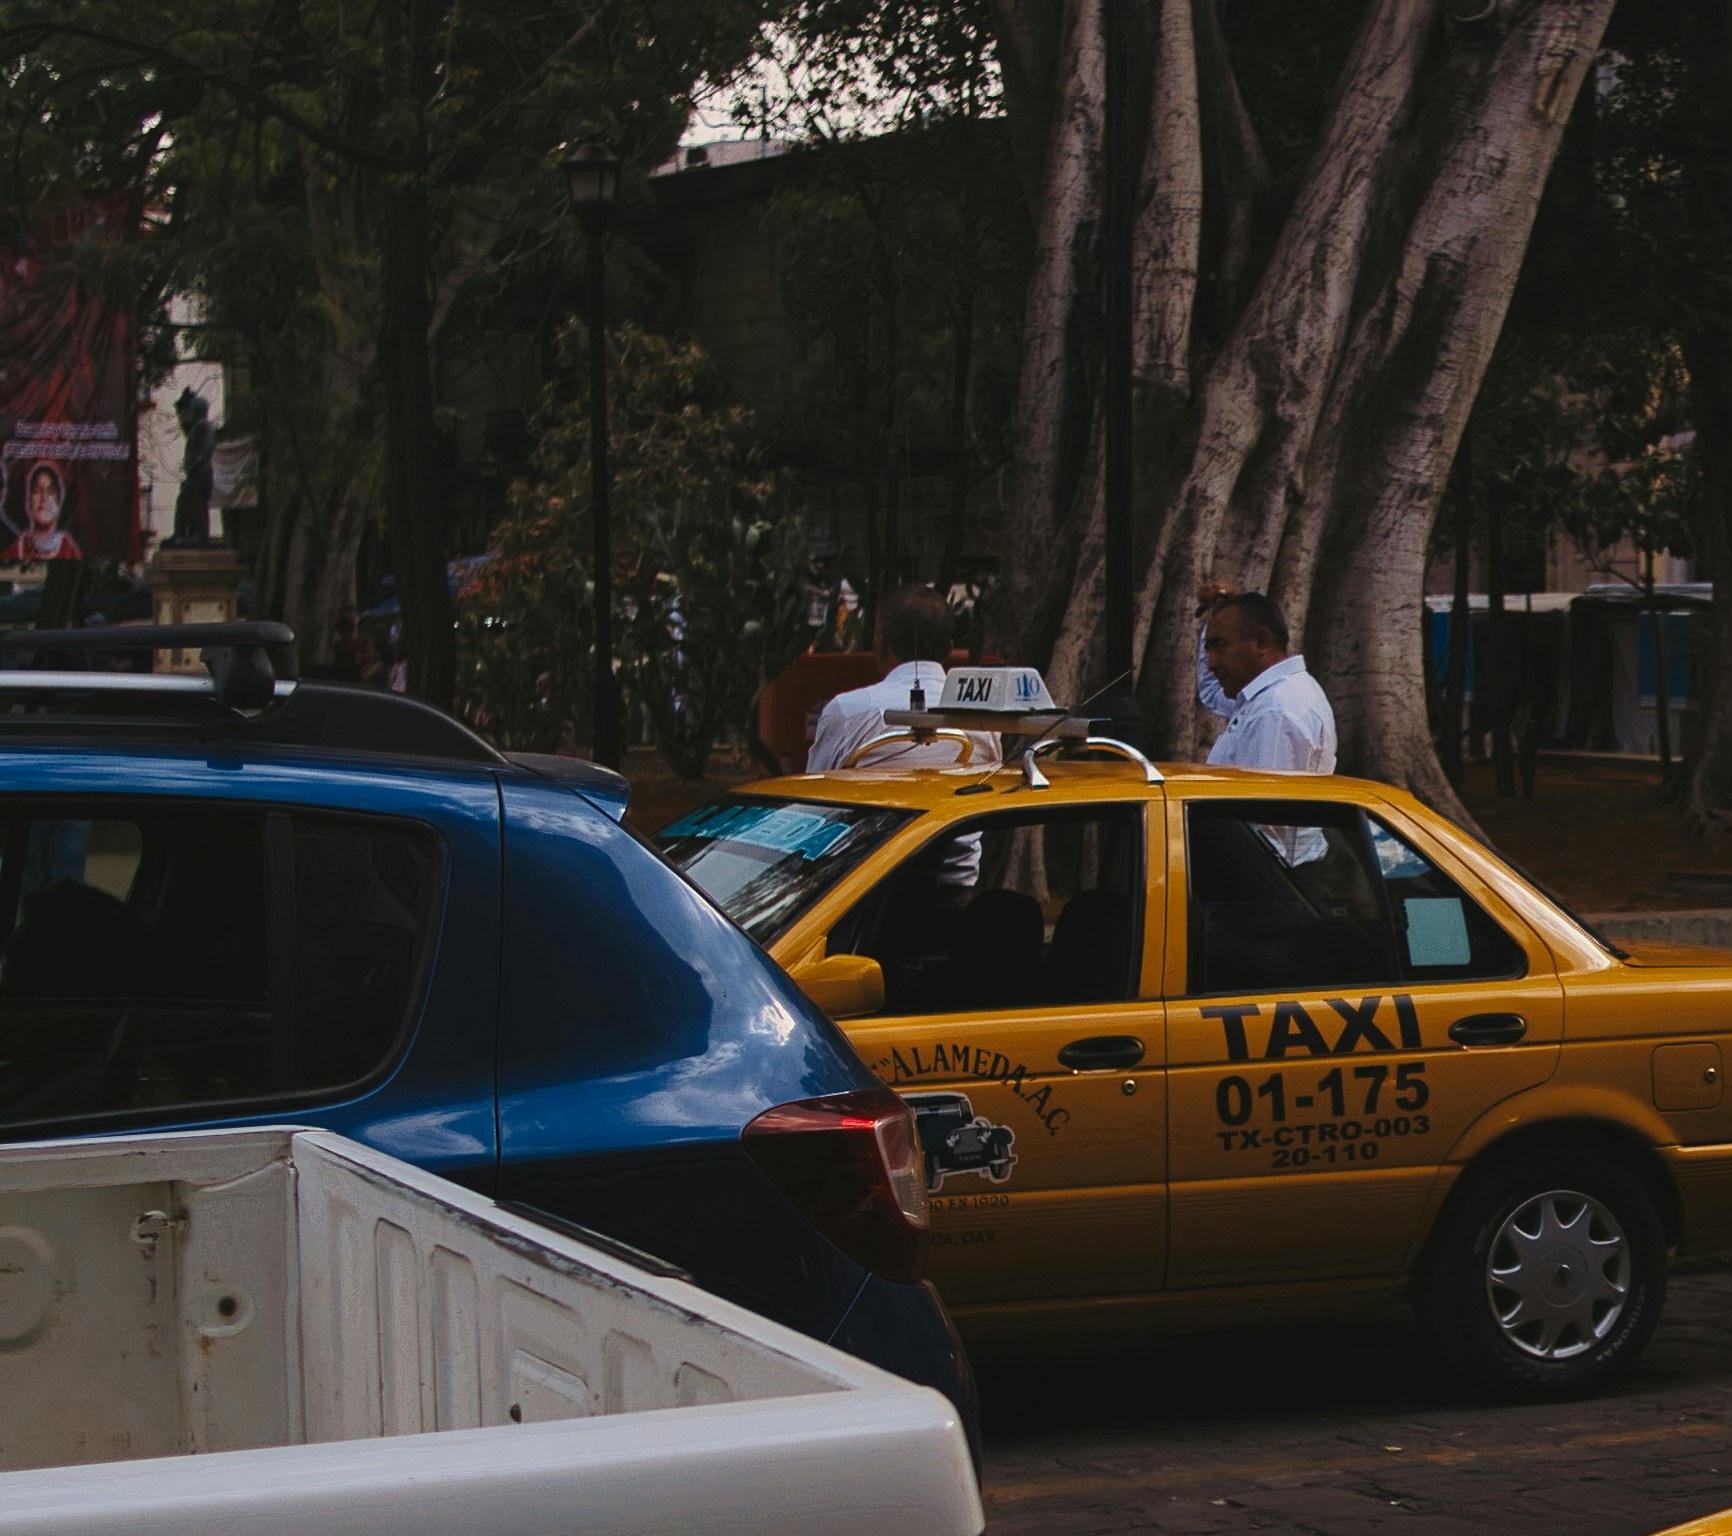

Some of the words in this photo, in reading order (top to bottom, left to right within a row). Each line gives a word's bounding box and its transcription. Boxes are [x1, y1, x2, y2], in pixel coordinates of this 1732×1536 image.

[957, 677, 993, 702] TAXI
[1200, 994, 1422, 1062] TAXI
[1216, 1062, 1430, 1127] 01-175
[1216, 1115, 1431, 1152] TX-CTRO-003
[1272, 1141, 1379, 1168] 20-110
